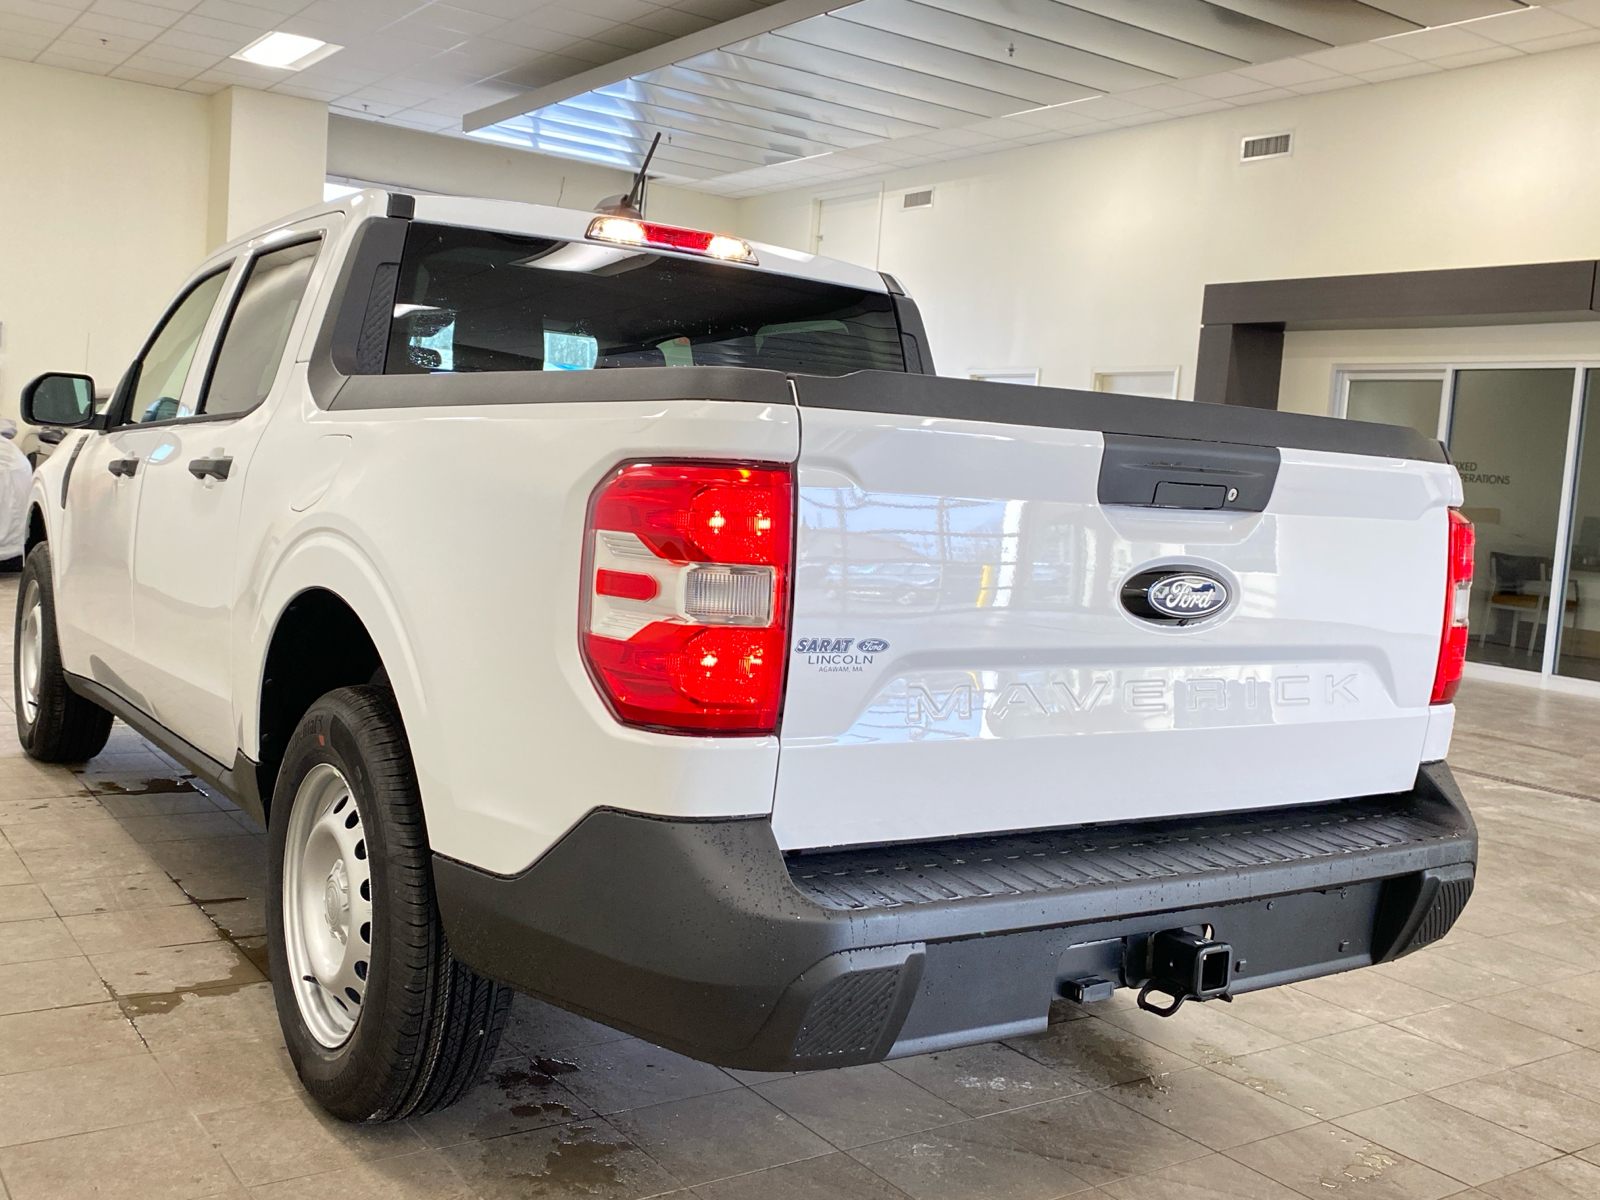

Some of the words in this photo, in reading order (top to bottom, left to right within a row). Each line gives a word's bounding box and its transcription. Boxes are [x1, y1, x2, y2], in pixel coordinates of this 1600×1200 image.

[1459, 473, 1511, 485] PERATIONS
[1164, 579, 1216, 609] Ford
[795, 637, 855, 654] SARAT
[807, 655, 874, 665] LINCOLN
[904, 673, 1360, 724] MAVERICK
